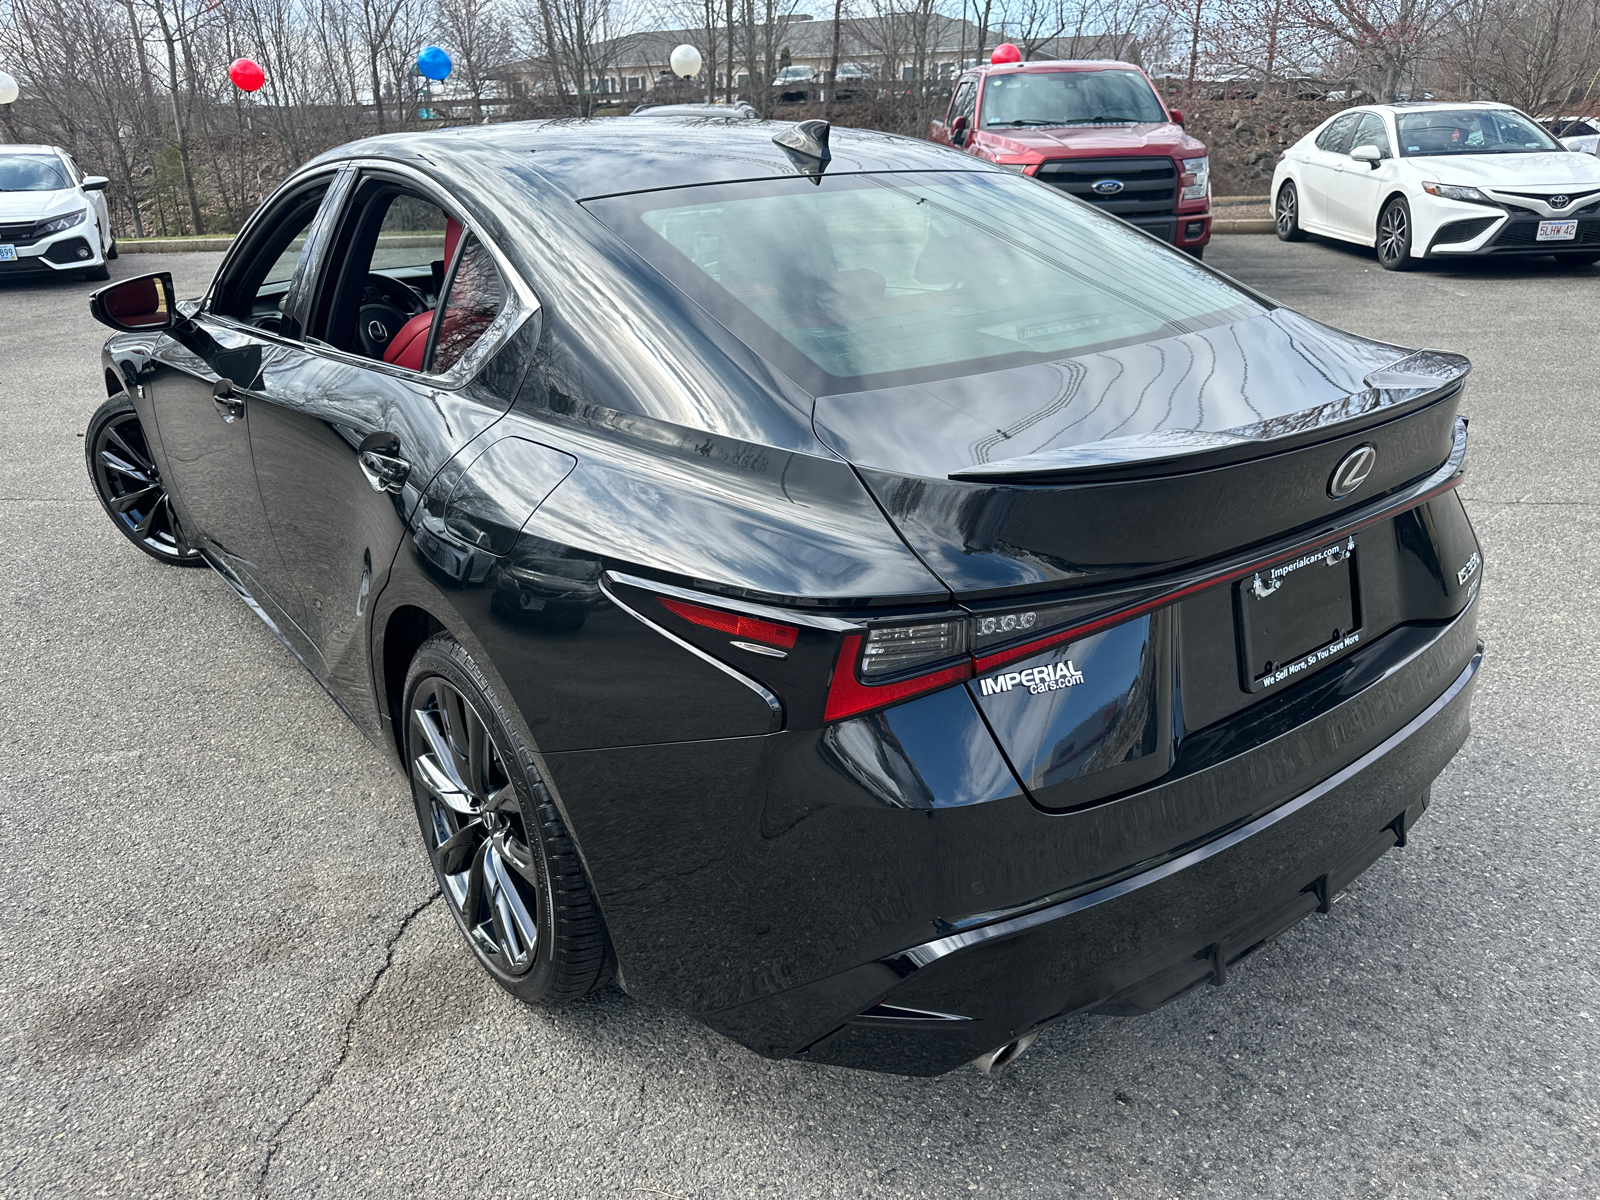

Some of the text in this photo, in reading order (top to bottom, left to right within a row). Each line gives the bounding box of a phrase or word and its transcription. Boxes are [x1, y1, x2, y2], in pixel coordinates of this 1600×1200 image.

[1563, 225, 1575, 235] 42
[1270, 545, 1340, 578] Imperialcars.com
[1262, 634, 1359, 688] We Sell More, So You Save More
[980, 660, 1083, 696] IMPERIAL
[1029, 673, 1085, 695] cars.com
